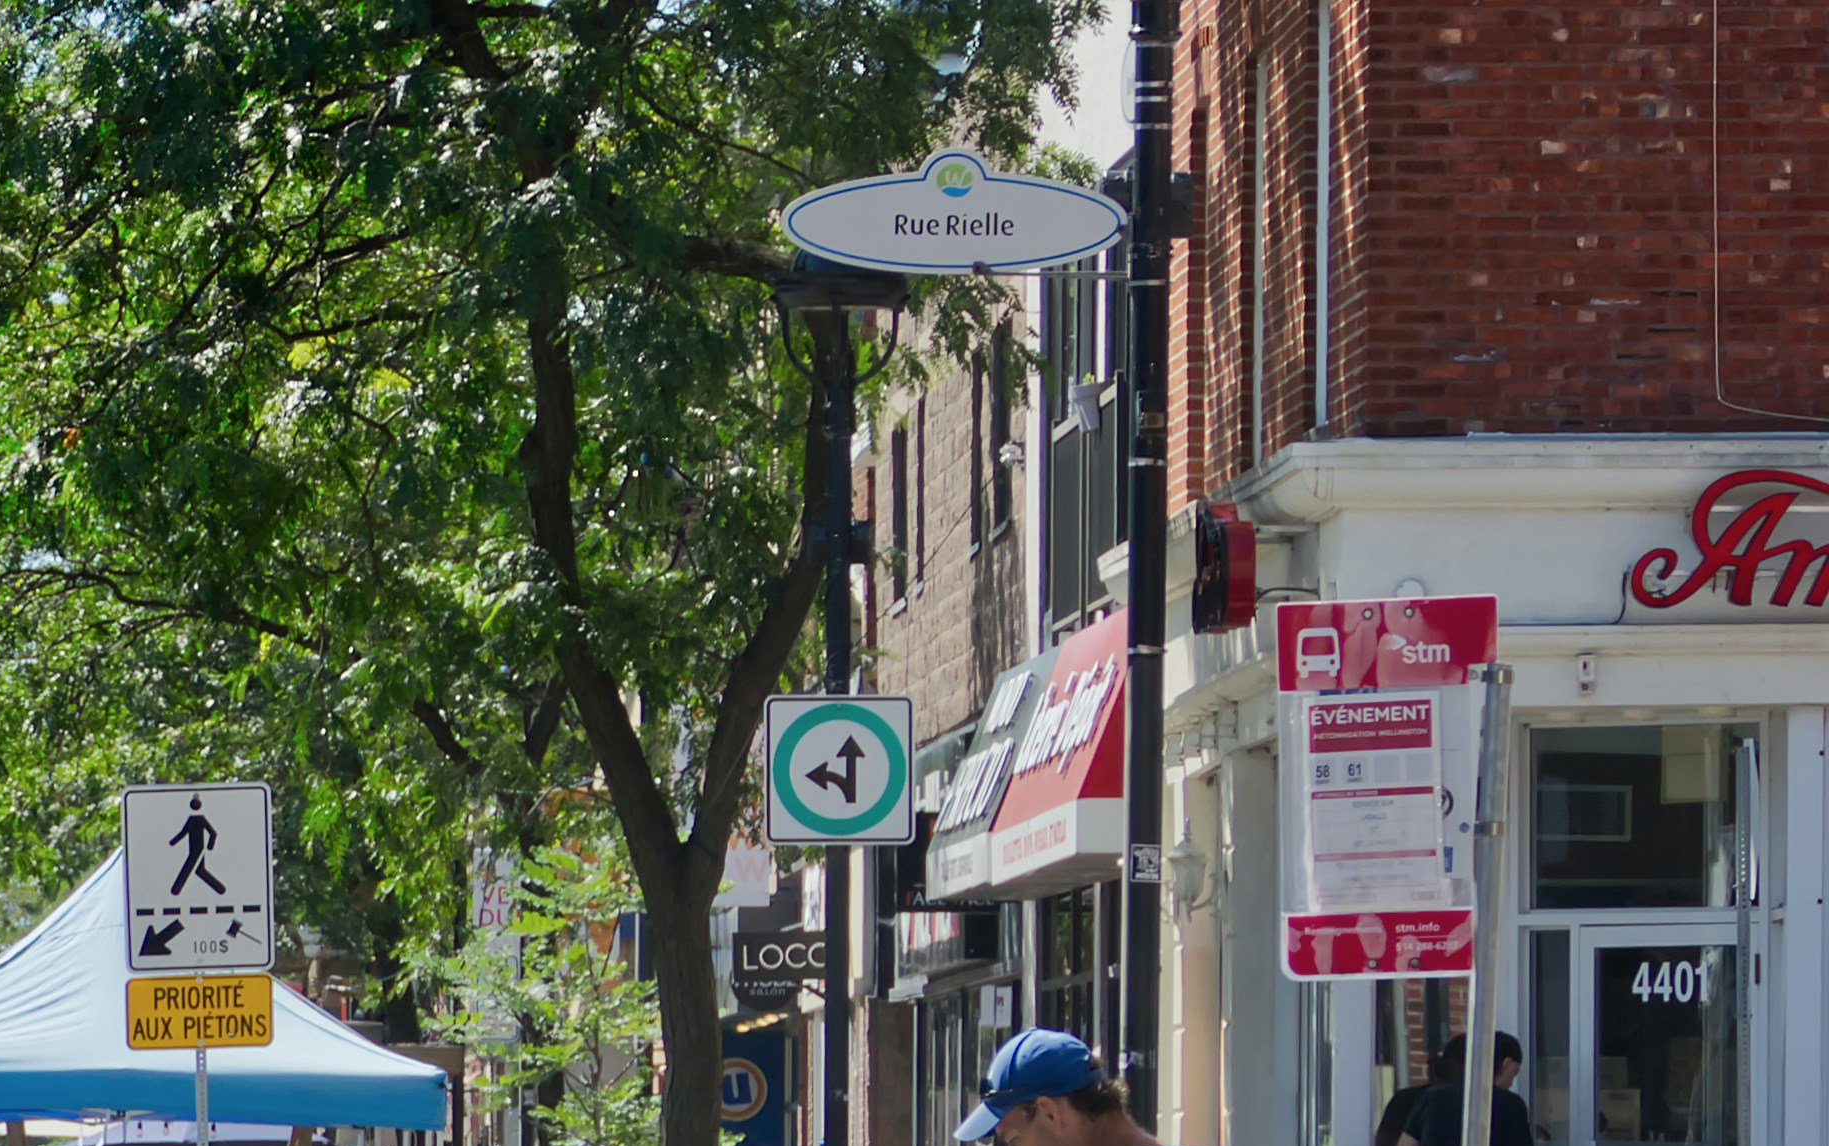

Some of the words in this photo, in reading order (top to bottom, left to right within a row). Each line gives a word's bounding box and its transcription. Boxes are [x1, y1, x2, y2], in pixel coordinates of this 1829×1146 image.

[894, 213, 939, 236] Rue
[946, 211, 1015, 237] Rielle
[1401, 641, 1450, 664] stm
[1310, 703, 1430, 726] ÉVÉNEMENT
[1315, 764, 1330, 779] 58
[1347, 762, 1362, 777] 61
[1395, 921, 1440, 934] stm.info
[1631, 960, 1708, 1003] 4401
[153, 979, 245, 1011] PRIORITÉ
[132, 1016, 173, 1041] AUX
[183, 1011, 268, 1040] PIÉTONS
